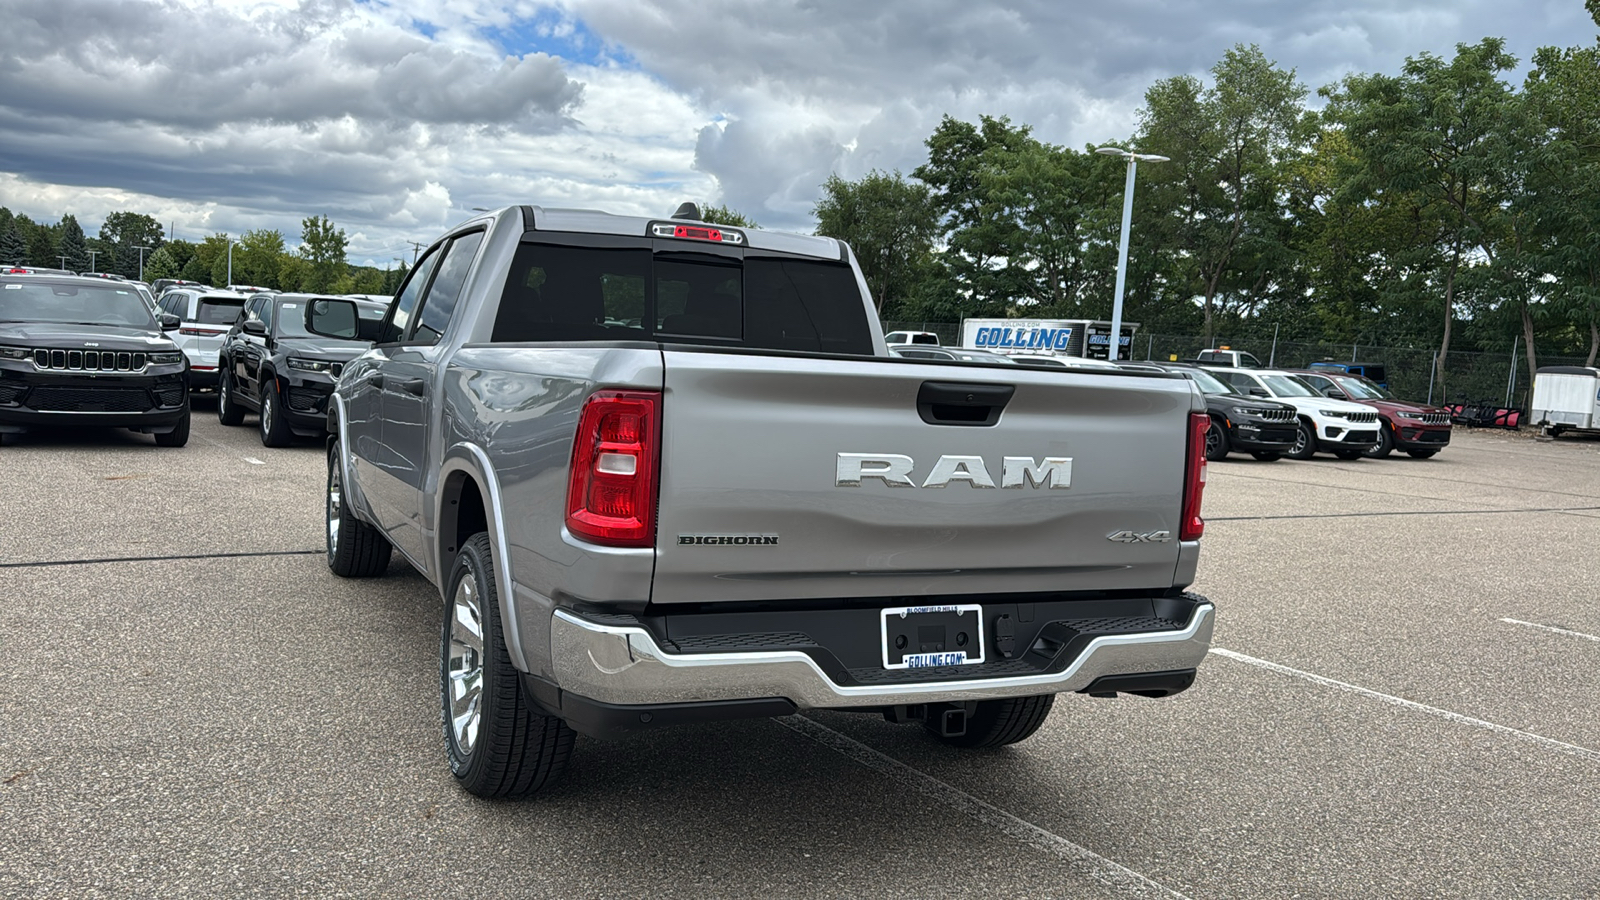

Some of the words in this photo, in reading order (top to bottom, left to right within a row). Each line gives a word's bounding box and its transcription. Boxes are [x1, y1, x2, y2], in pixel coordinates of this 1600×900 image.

[975, 327, 1073, 350] GOLLING
[1089, 334, 1130, 345] GOLLNG
[835, 452, 1073, 489] RAM
[677, 534, 779, 546] BIGHORN
[1106, 530, 1171, 543] 4x4
[908, 653, 963, 668] GOLLING.COM
